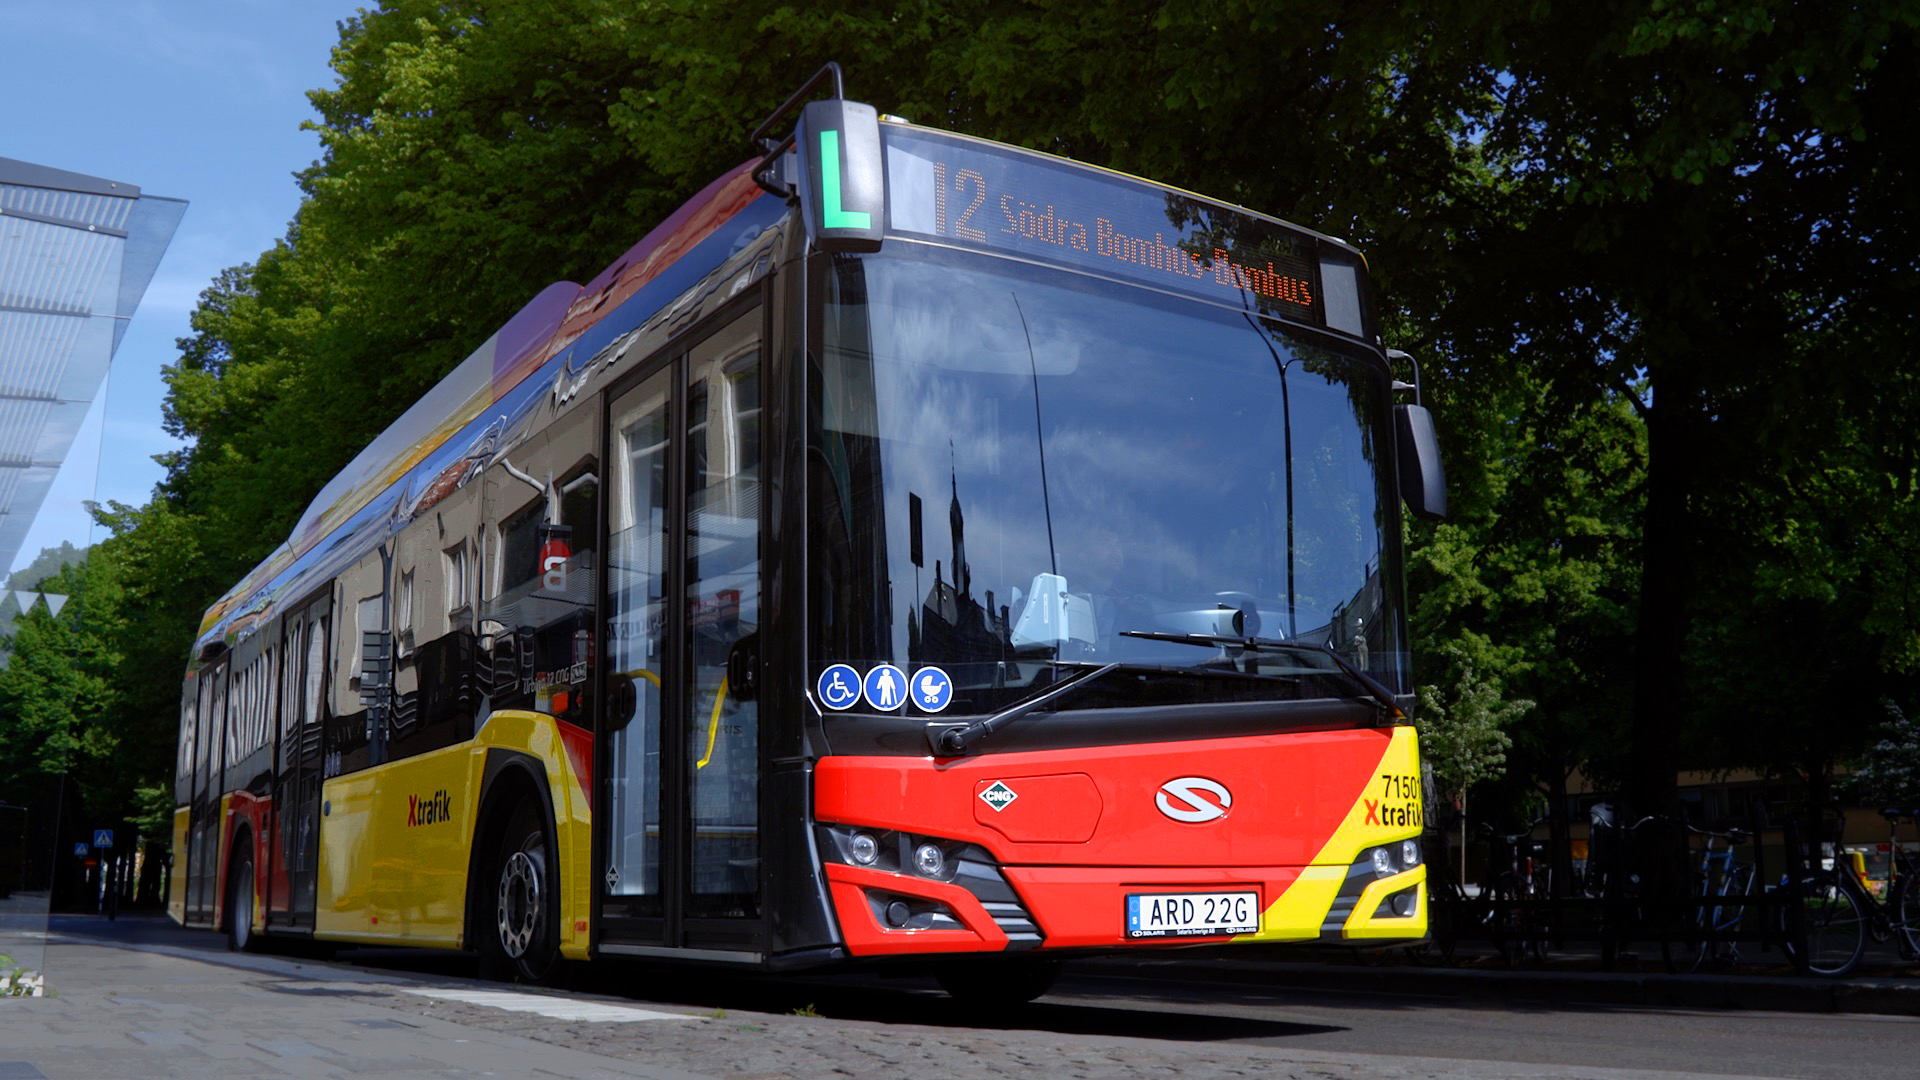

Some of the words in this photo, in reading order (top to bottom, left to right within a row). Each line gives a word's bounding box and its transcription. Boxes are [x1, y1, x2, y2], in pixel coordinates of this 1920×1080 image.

[934, 162, 986, 243] 12
[1001, 194, 1089, 252] Södra
[986, 791, 1011, 801] CNG
[1132, 916, 1138, 925] S
[1150, 899, 1195, 925] ARD
[1204, 898, 1247, 923] 22G
